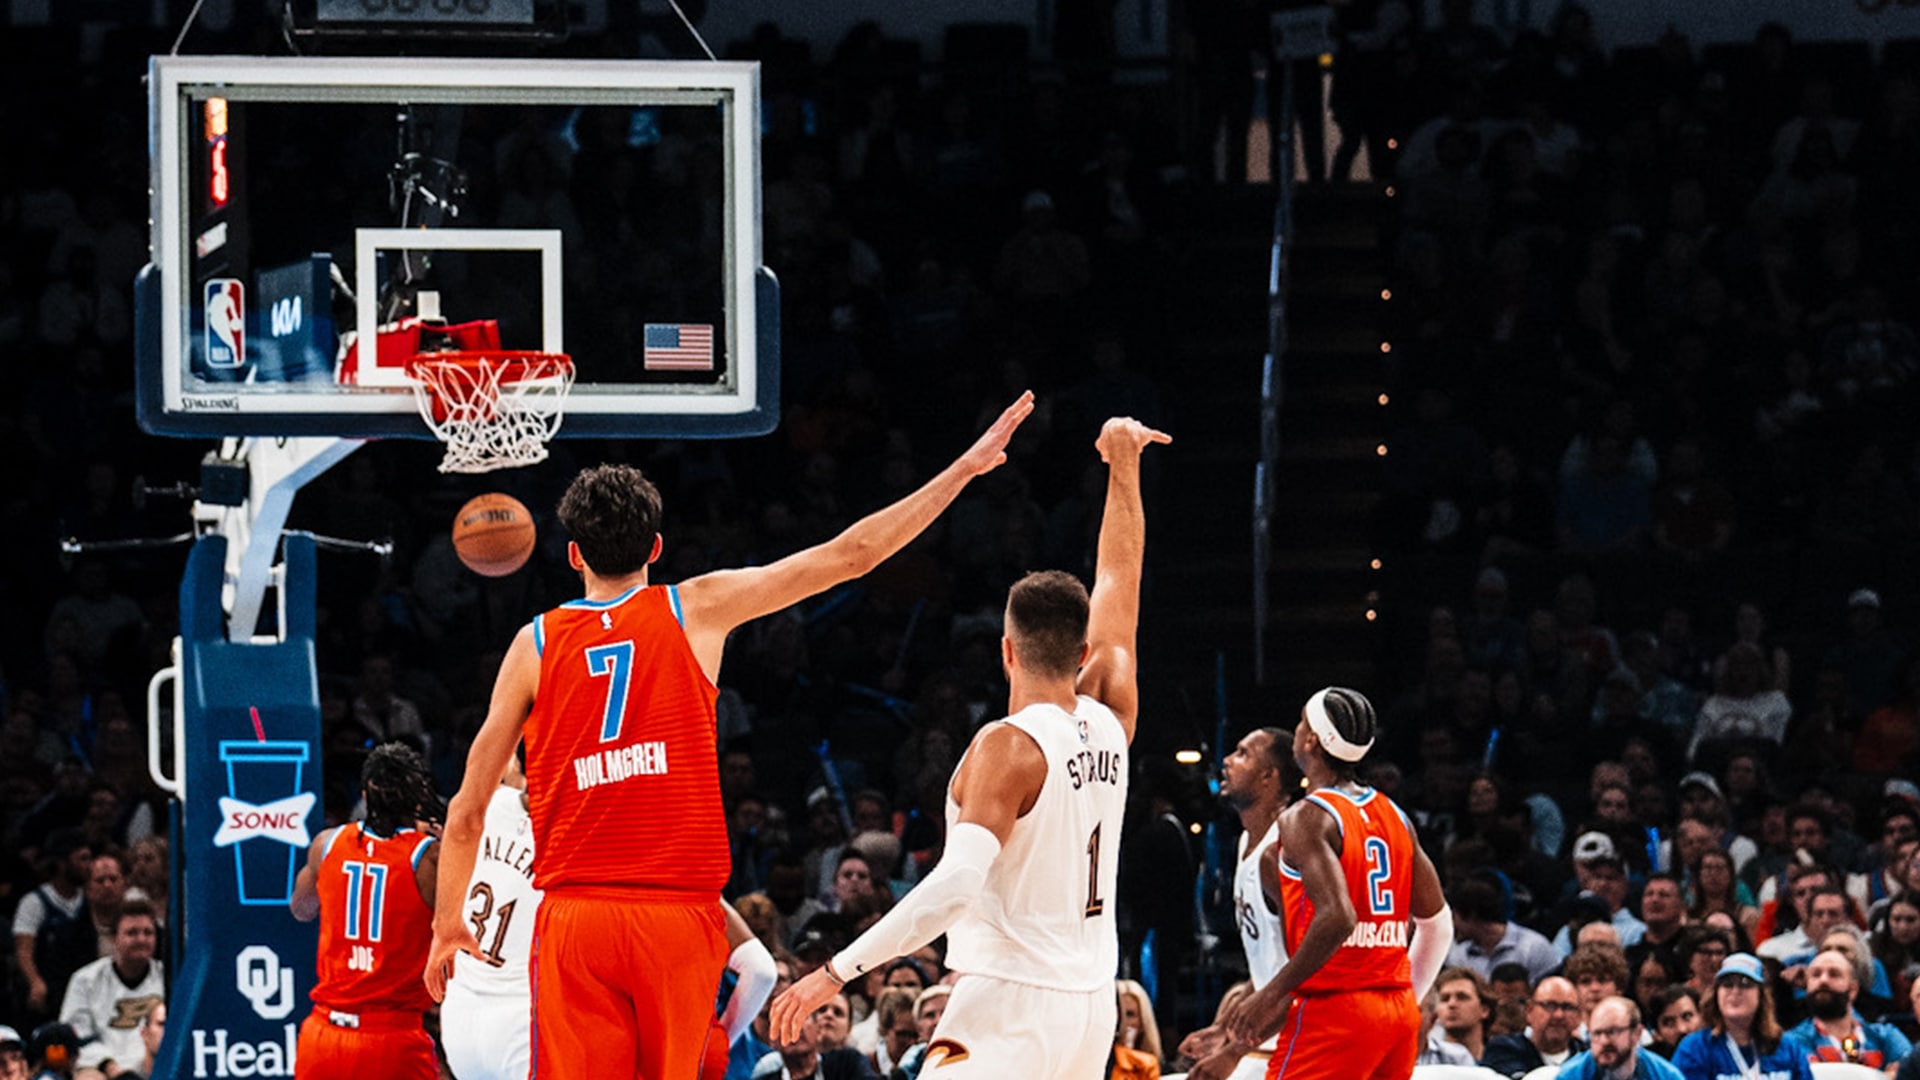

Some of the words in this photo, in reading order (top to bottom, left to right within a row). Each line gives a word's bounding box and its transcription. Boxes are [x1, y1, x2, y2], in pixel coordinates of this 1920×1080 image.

[181, 397, 240, 411] SPALDING
[584, 639, 636, 744] 7
[573, 741, 668, 791] HOLMGREN
[1066, 751, 1120, 790] STRUS
[229, 812, 300, 830] SONIC
[1085, 820, 1104, 918] 1
[1364, 835, 1394, 915] 2
[341, 860, 388, 943] 11
[468, 881, 518, 969] 31
[236, 945, 295, 1019] OU
[347, 945, 374, 972] JOE
[192, 1023, 297, 1078] Heal
